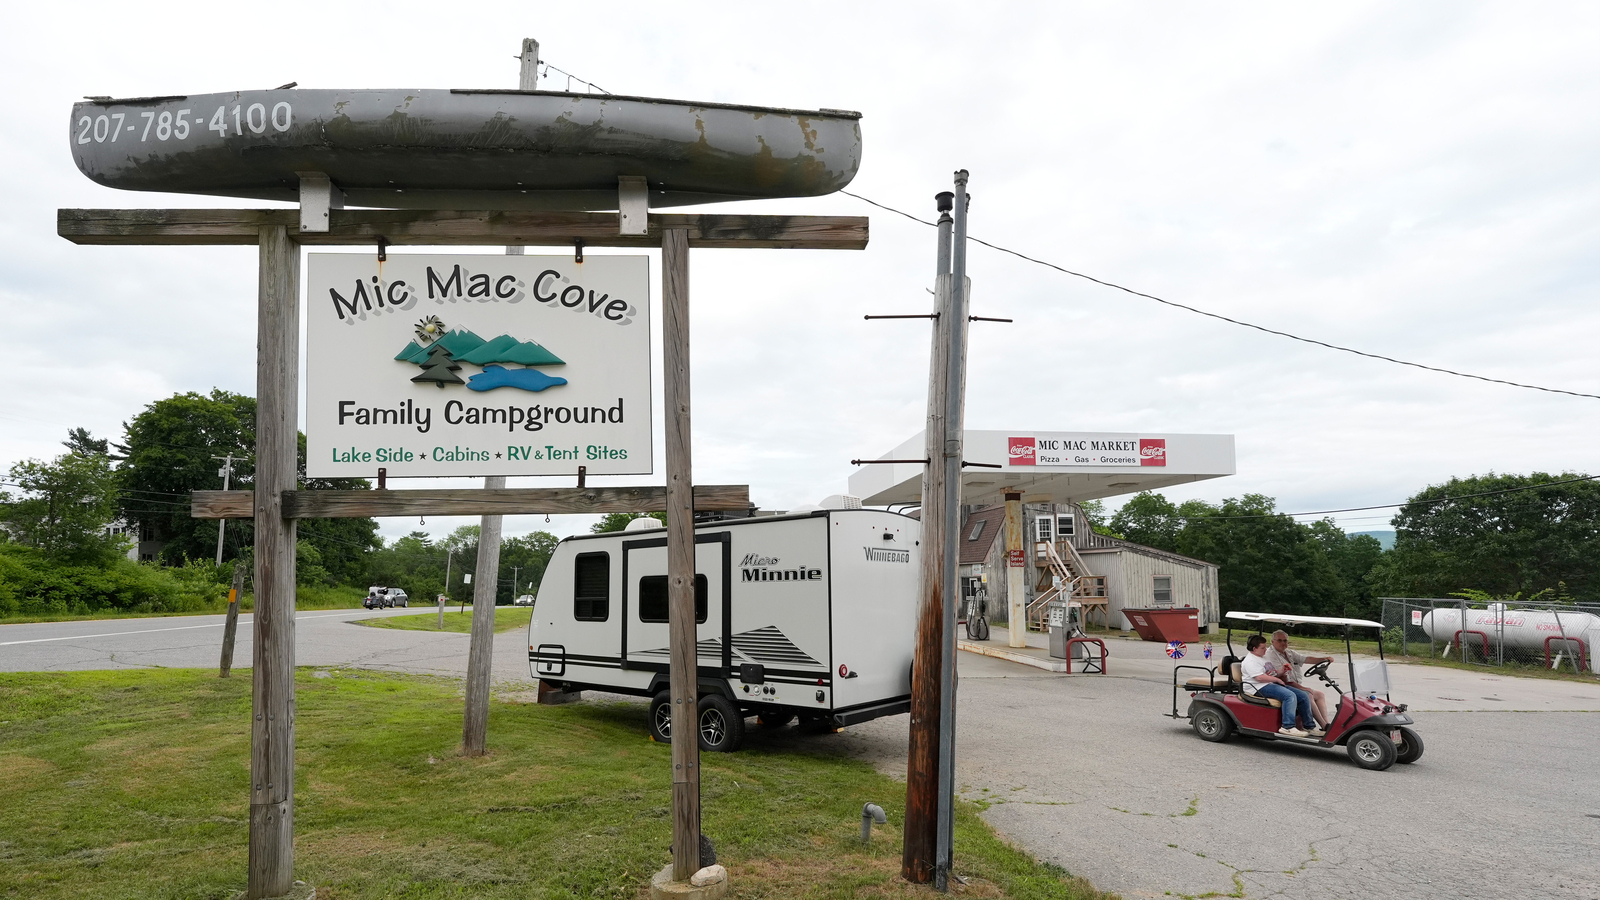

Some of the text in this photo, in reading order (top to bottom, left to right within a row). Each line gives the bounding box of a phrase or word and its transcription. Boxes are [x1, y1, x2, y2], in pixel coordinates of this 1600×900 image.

[77, 101, 292, 145] 207-785-4100
[329, 264, 629, 321] Mic Mac Cove
[338, 397, 624, 433] Family Campground
[332, 447, 371, 463] Lake
[375, 447, 414, 462] Side
[432, 446, 490, 462] Cabins
[507, 445, 532, 461] RV
[545, 445, 579, 461] Tent
[586, 444, 628, 460] Sites
[1038, 440, 1137, 451] MIC MAC MARKET
[1040, 455, 1060, 463] Pizza
[1100, 456, 1136, 464] Groceries
[738, 553, 780, 567] Micro
[741, 565, 822, 582] Minnie
